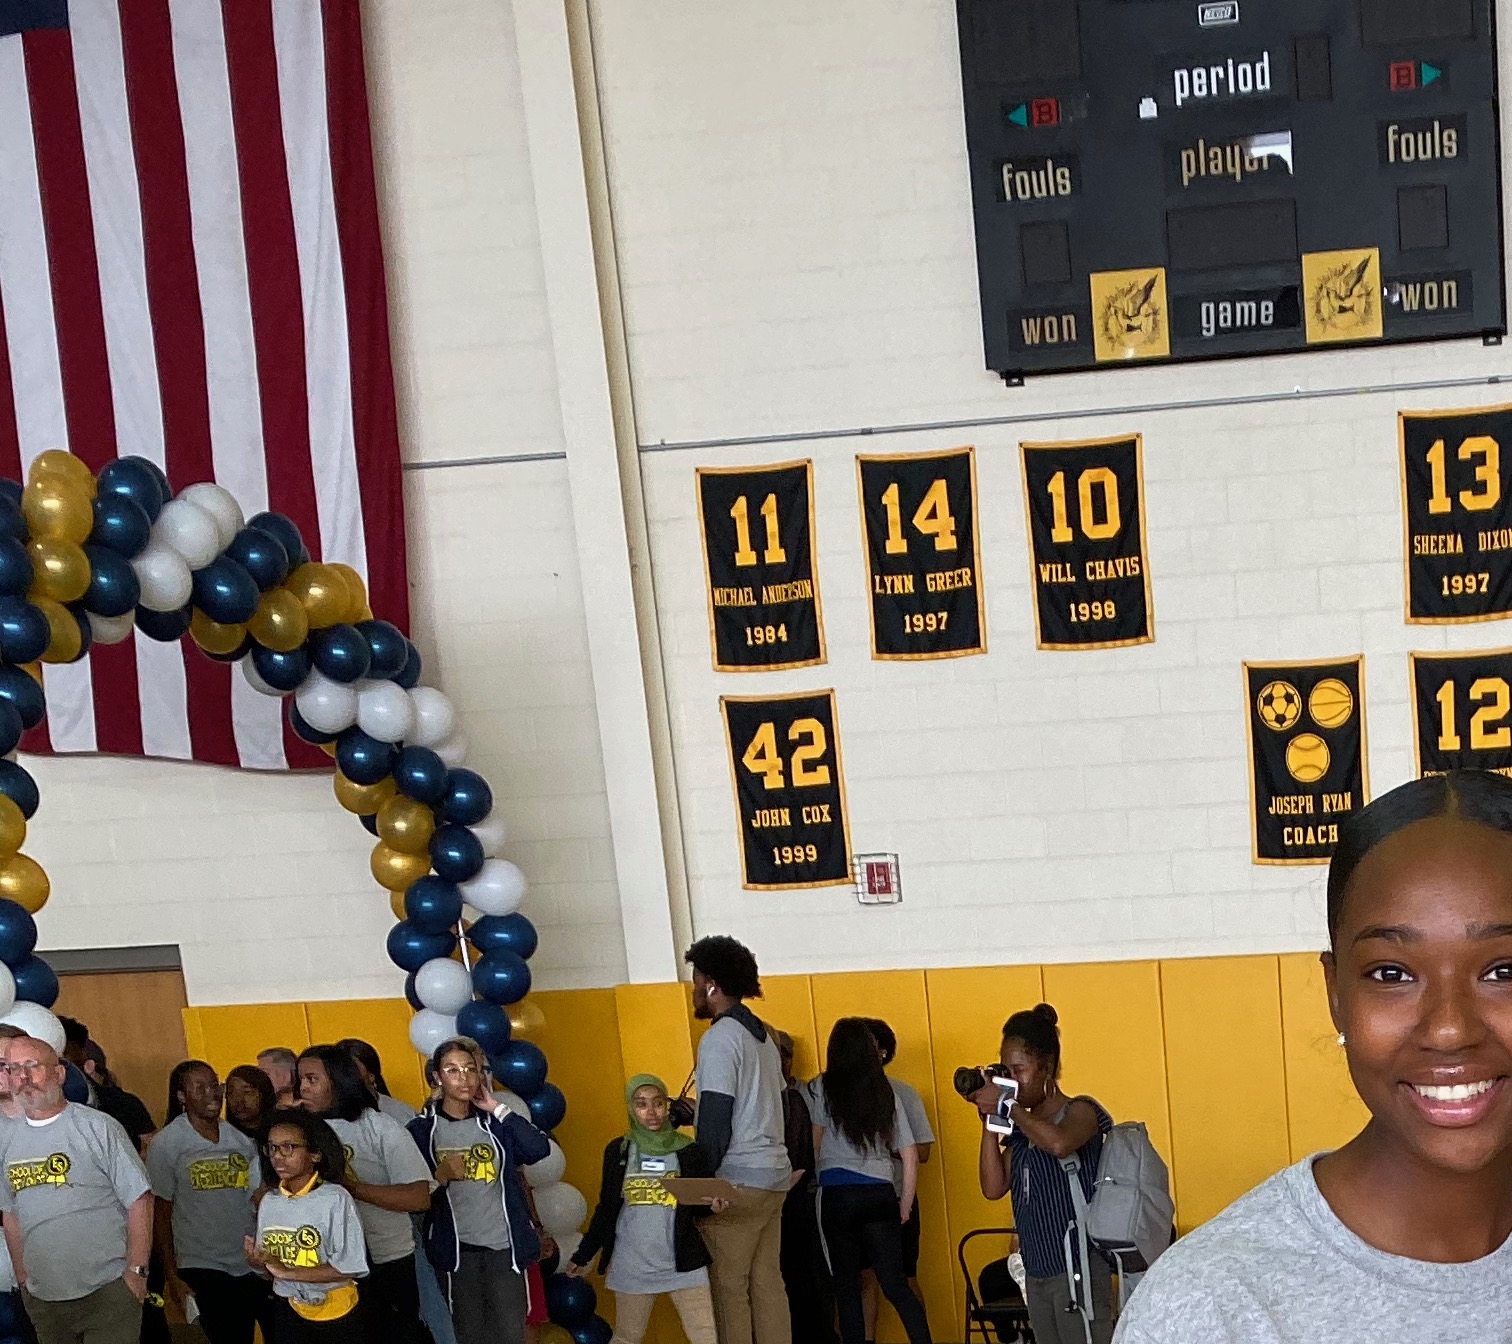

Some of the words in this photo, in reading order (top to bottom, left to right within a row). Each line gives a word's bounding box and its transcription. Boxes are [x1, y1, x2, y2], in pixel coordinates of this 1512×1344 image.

[1174, 51, 1271, 107] period
[1387, 119, 1458, 163] fouls
[1002, 158, 1071, 201] fouls
[1401, 279, 1458, 312] won
[1021, 312, 1077, 346] won
[1201, 296, 1274, 337] game
[1427, 436, 1500, 514] 13
[882, 479, 957, 554] 14
[1048, 467, 1120, 542] 10
[731, 494, 786, 566] 11
[1414, 534, 1463, 554] SHEENA
[875, 575, 914, 594] LYNN
[926, 568, 972, 592] GREER
[1039, 563, 1075, 582] WILL
[1086, 556, 1140, 580] CHAVIS
[763, 578, 813, 604] ANDERSON
[1443, 573, 1489, 595] 1997
[905, 612, 947, 633] 1997
[1070, 601, 1115, 622] 1998
[746, 624, 787, 645] 1984
[1436, 678, 1511, 750] 12
[742, 718, 831, 789] 42
[752, 808, 791, 827] JOHN
[802, 804, 831, 824] COX
[1269, 795, 1313, 814] JOSEPH
[1323, 792, 1351, 812] RYAN
[1284, 824, 1338, 845] COACH
[774, 845, 817, 864] 1999
